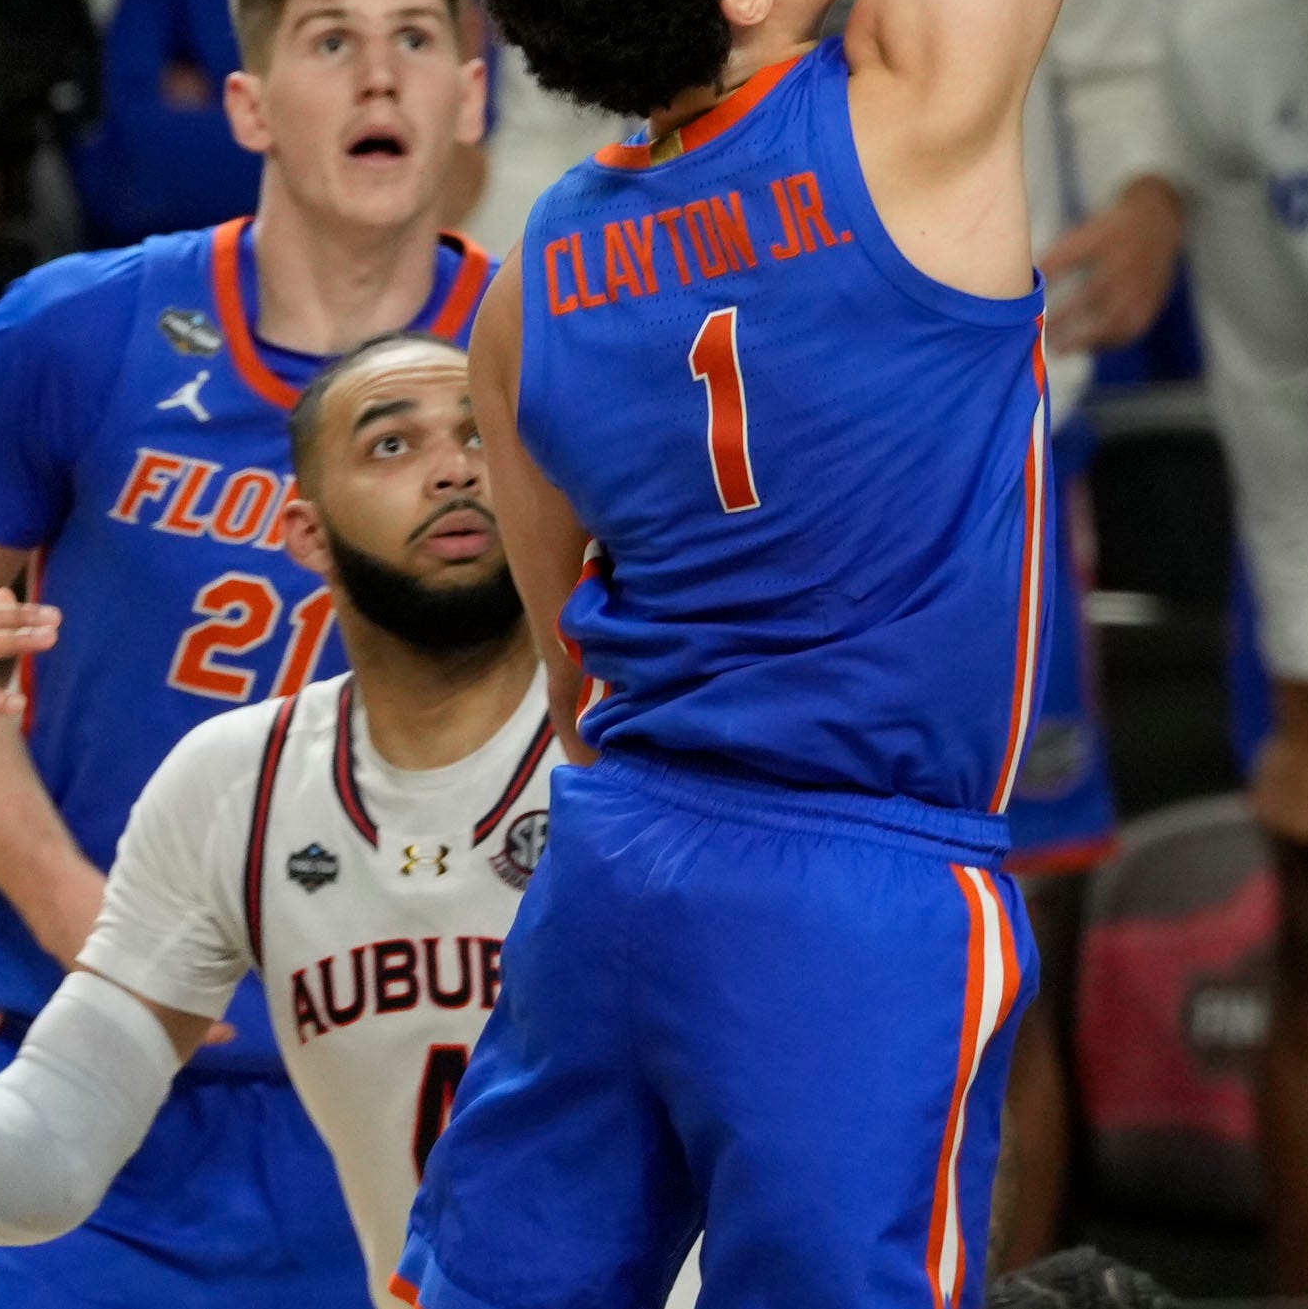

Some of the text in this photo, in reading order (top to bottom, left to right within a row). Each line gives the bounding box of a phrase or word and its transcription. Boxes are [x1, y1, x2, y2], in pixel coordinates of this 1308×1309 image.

[544, 171, 853, 316] CLAYTON JR.
[687, 305, 761, 514] 1
[166, 570, 338, 704] 21
